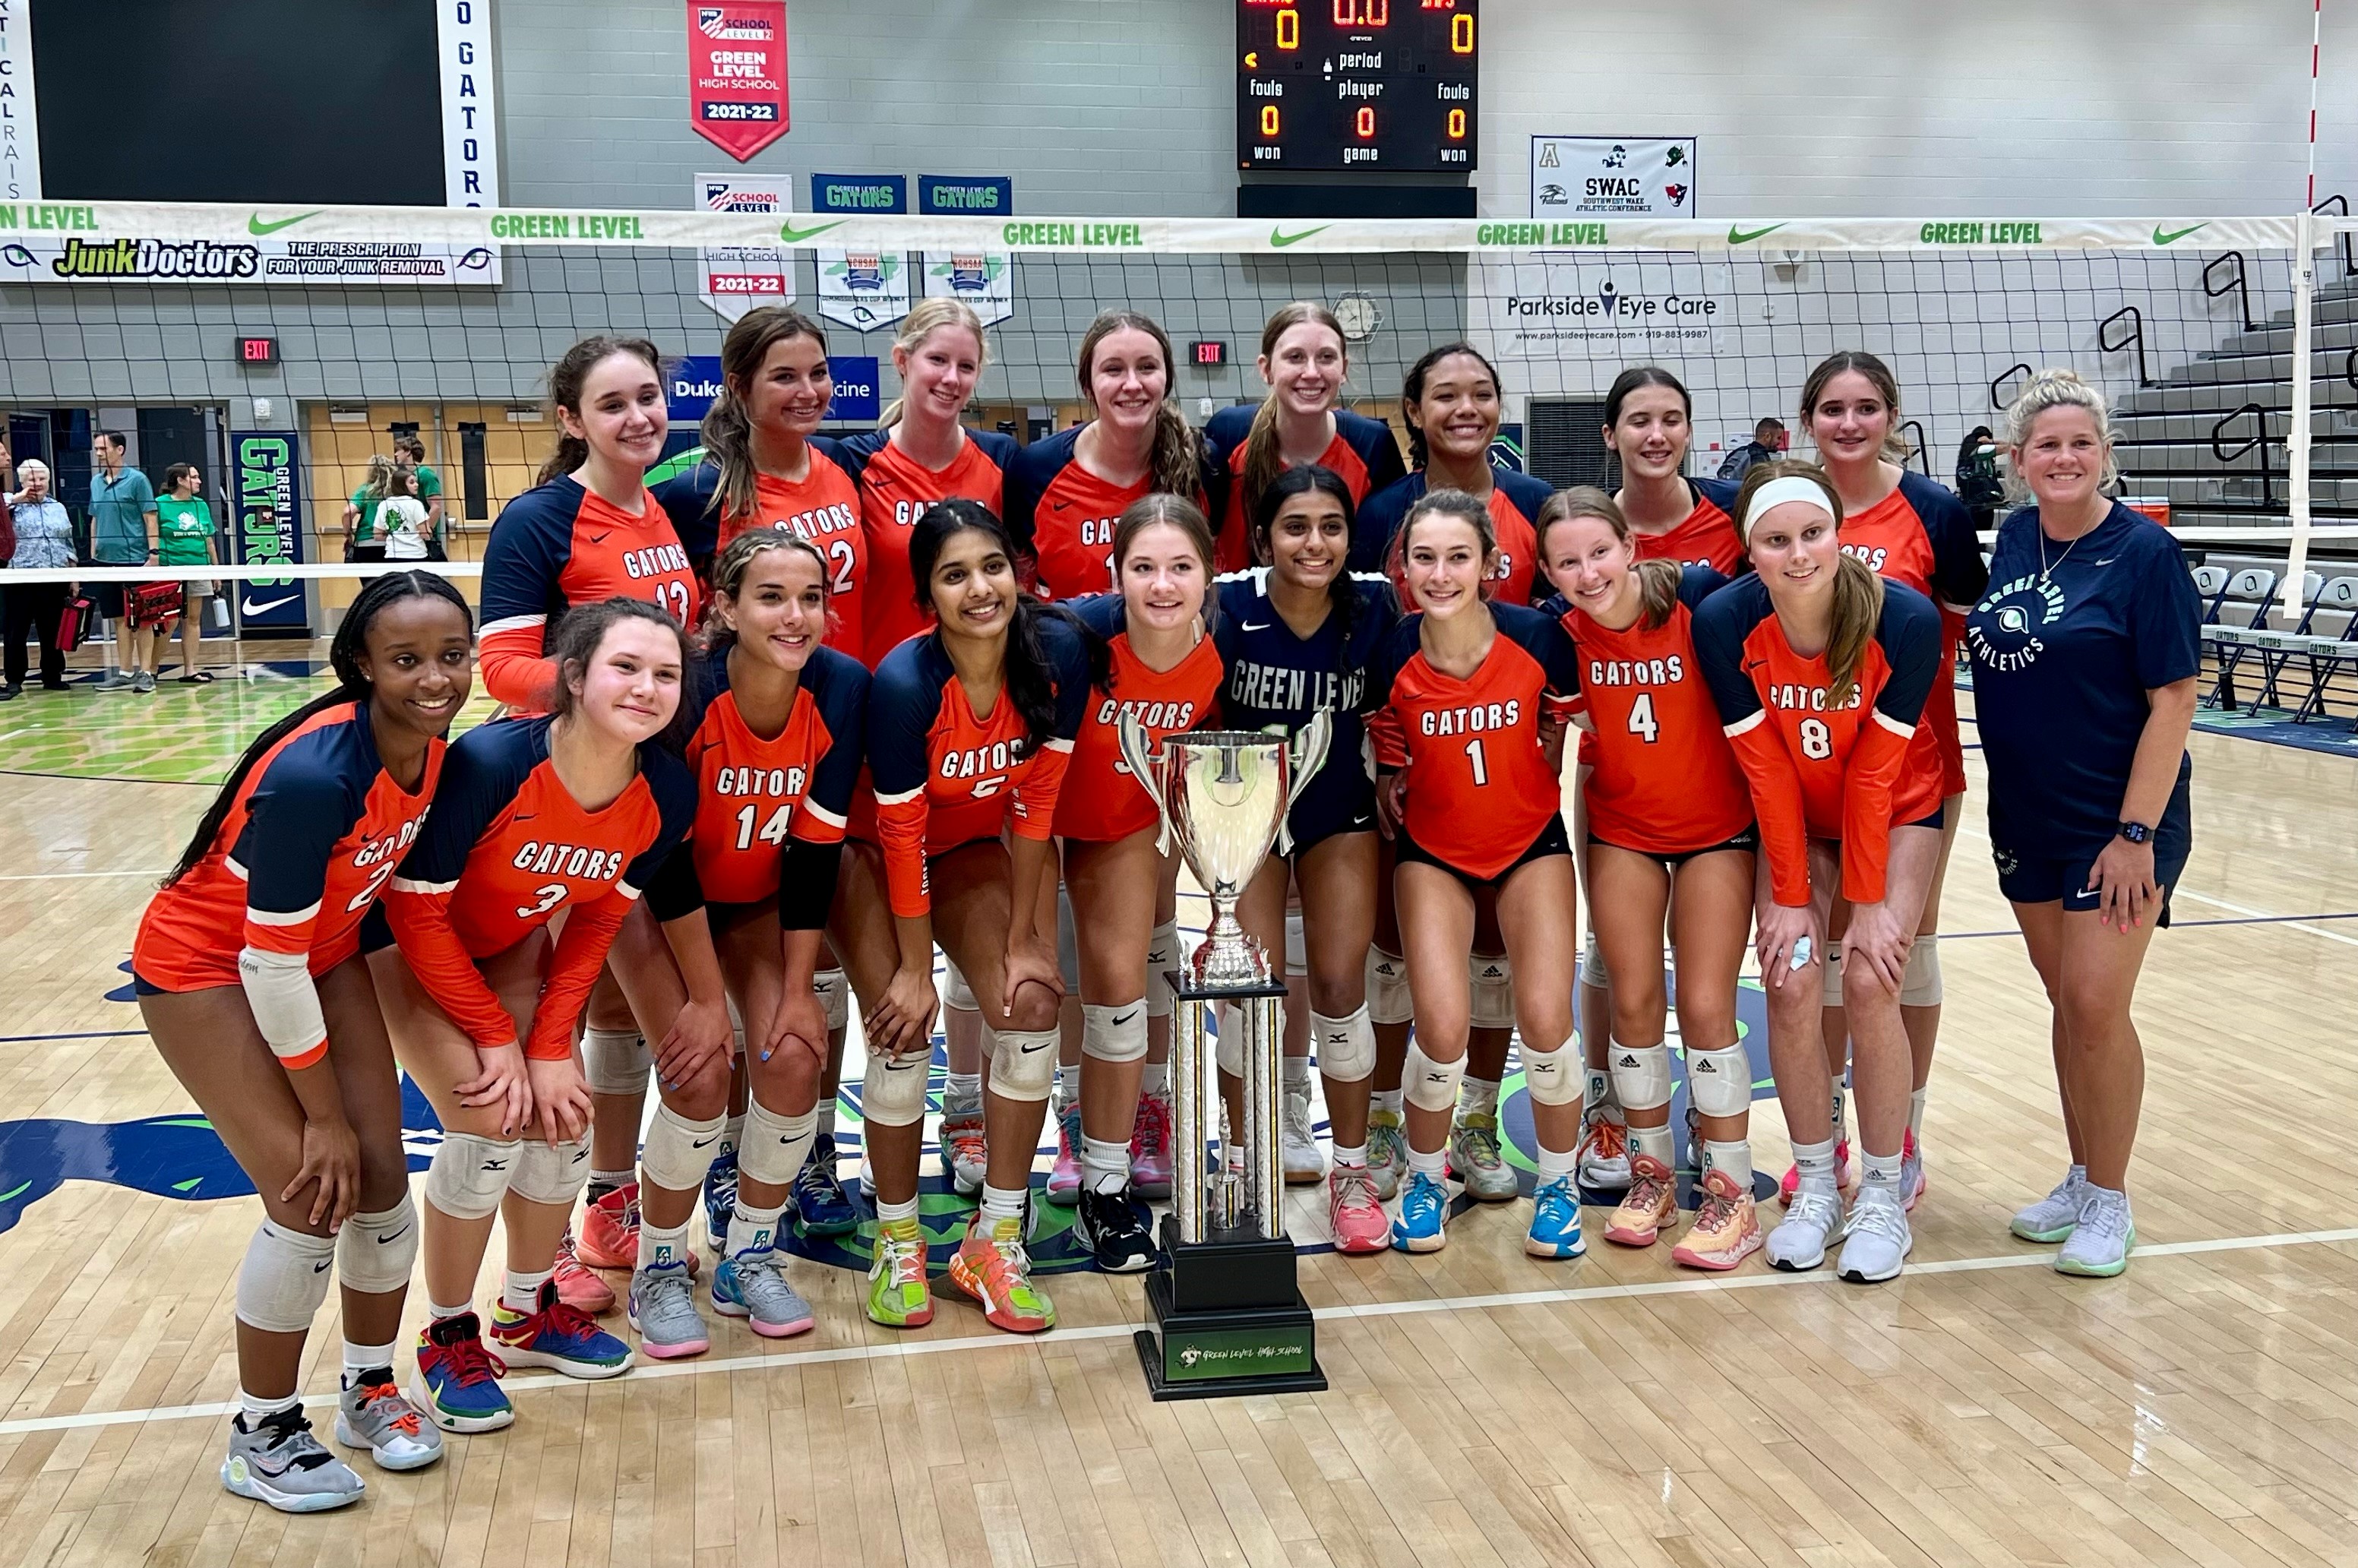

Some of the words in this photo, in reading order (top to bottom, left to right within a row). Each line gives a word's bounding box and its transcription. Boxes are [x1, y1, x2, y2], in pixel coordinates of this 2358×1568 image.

[725, 20, 773, 29] SCHOOL
[764, 30, 772, 39] 2
[1276, 9, 1299, 49] 0
[1452, 14, 1474, 53] 0
[710, 50, 767, 65] GREEN
[1339, 51, 1381, 71] period
[713, 65, 765, 77] LEVEL
[699, 78, 729, 89] HIGH
[731, 79, 780, 90] SCHOOL
[1250, 79, 1282, 96] fouls
[1339, 79, 1383, 100] player
[1438, 83, 1469, 100] fouls
[708, 104, 773, 119] 2021-22
[1261, 105, 1279, 135] 0
[1357, 106, 1374, 137] 0
[459, 42, 482, 207] GATOR
[1449, 109, 1465, 138] 0
[1254, 146, 1281, 160] won
[1344, 147, 1378, 164] game
[1440, 149, 1467, 162] won
[732, 193, 779, 203] SCHOOL
[827, 185, 894, 207] GATORS
[933, 185, 998, 208] GATORS
[1585, 178, 1639, 197] SWAC
[27, 206, 99, 230] LEVEL
[733, 204, 767, 213] LEVEL
[491, 215, 572, 239] GREEN
[578, 216, 644, 239] LEVEL
[1003, 223, 1075, 246] GREEN
[1083, 224, 1143, 246] LEVEL
[1477, 224, 1545, 245] GREEN
[1551, 223, 1608, 245] LEVEL
[1920, 222, 1983, 244] GREEN
[1990, 223, 2043, 244] LEVEL
[53, 239, 259, 277] JunkDoctors
[289, 242, 318, 256] THE
[318, 242, 421, 257] PRESCRIPTION
[706, 252, 735, 261] HIGH
[267, 258, 296, 273] FOR
[299, 259, 335, 274] YOUR
[338, 259, 377, 275] JUNK
[380, 259, 445, 275] REMOVAL
[715, 277, 779, 291] 2021-22
[1507, 296, 1599, 315] Parkside
[1619, 296, 1656, 319] Eye
[1664, 295, 1717, 315] Care
[1645, 330, 1708, 339] 919-883-9987
[244, 340, 270, 360] EXIT
[1198, 344, 1220, 362] EXIT
[675, 380, 725, 397] Duke
[834, 381, 870, 397] cine
[276, 466, 292, 511] GREEN
[279, 516, 294, 557] LEVEL
[623, 542, 689, 580] GATORS
[2216, 631, 2239, 642] GATORS
[2258, 637, 2281, 648] GATORS
[1968, 627, 2043, 671] ATHLETICS
[2309, 643, 2337, 655] GATORS
[1590, 655, 1683, 686] GATORS
[1231, 659, 1305, 710] GREEN
[1770, 683, 1862, 713] GATOS
[1421, 698, 1520, 737] GATORS
[1628, 694, 1658, 744] 4
[1799, 716, 1834, 761] 8
[940, 734, 1032, 778] GATOR
[1465, 738, 1488, 786] 1
[736, 804, 794, 849] 14
[513, 841, 623, 881] GATORS
[347, 860, 395, 912] 2
[517, 884, 568, 918] 3
[1203, 1348, 1228, 1361] GREEN
[1229, 1348, 1253, 1359] LEVEL
